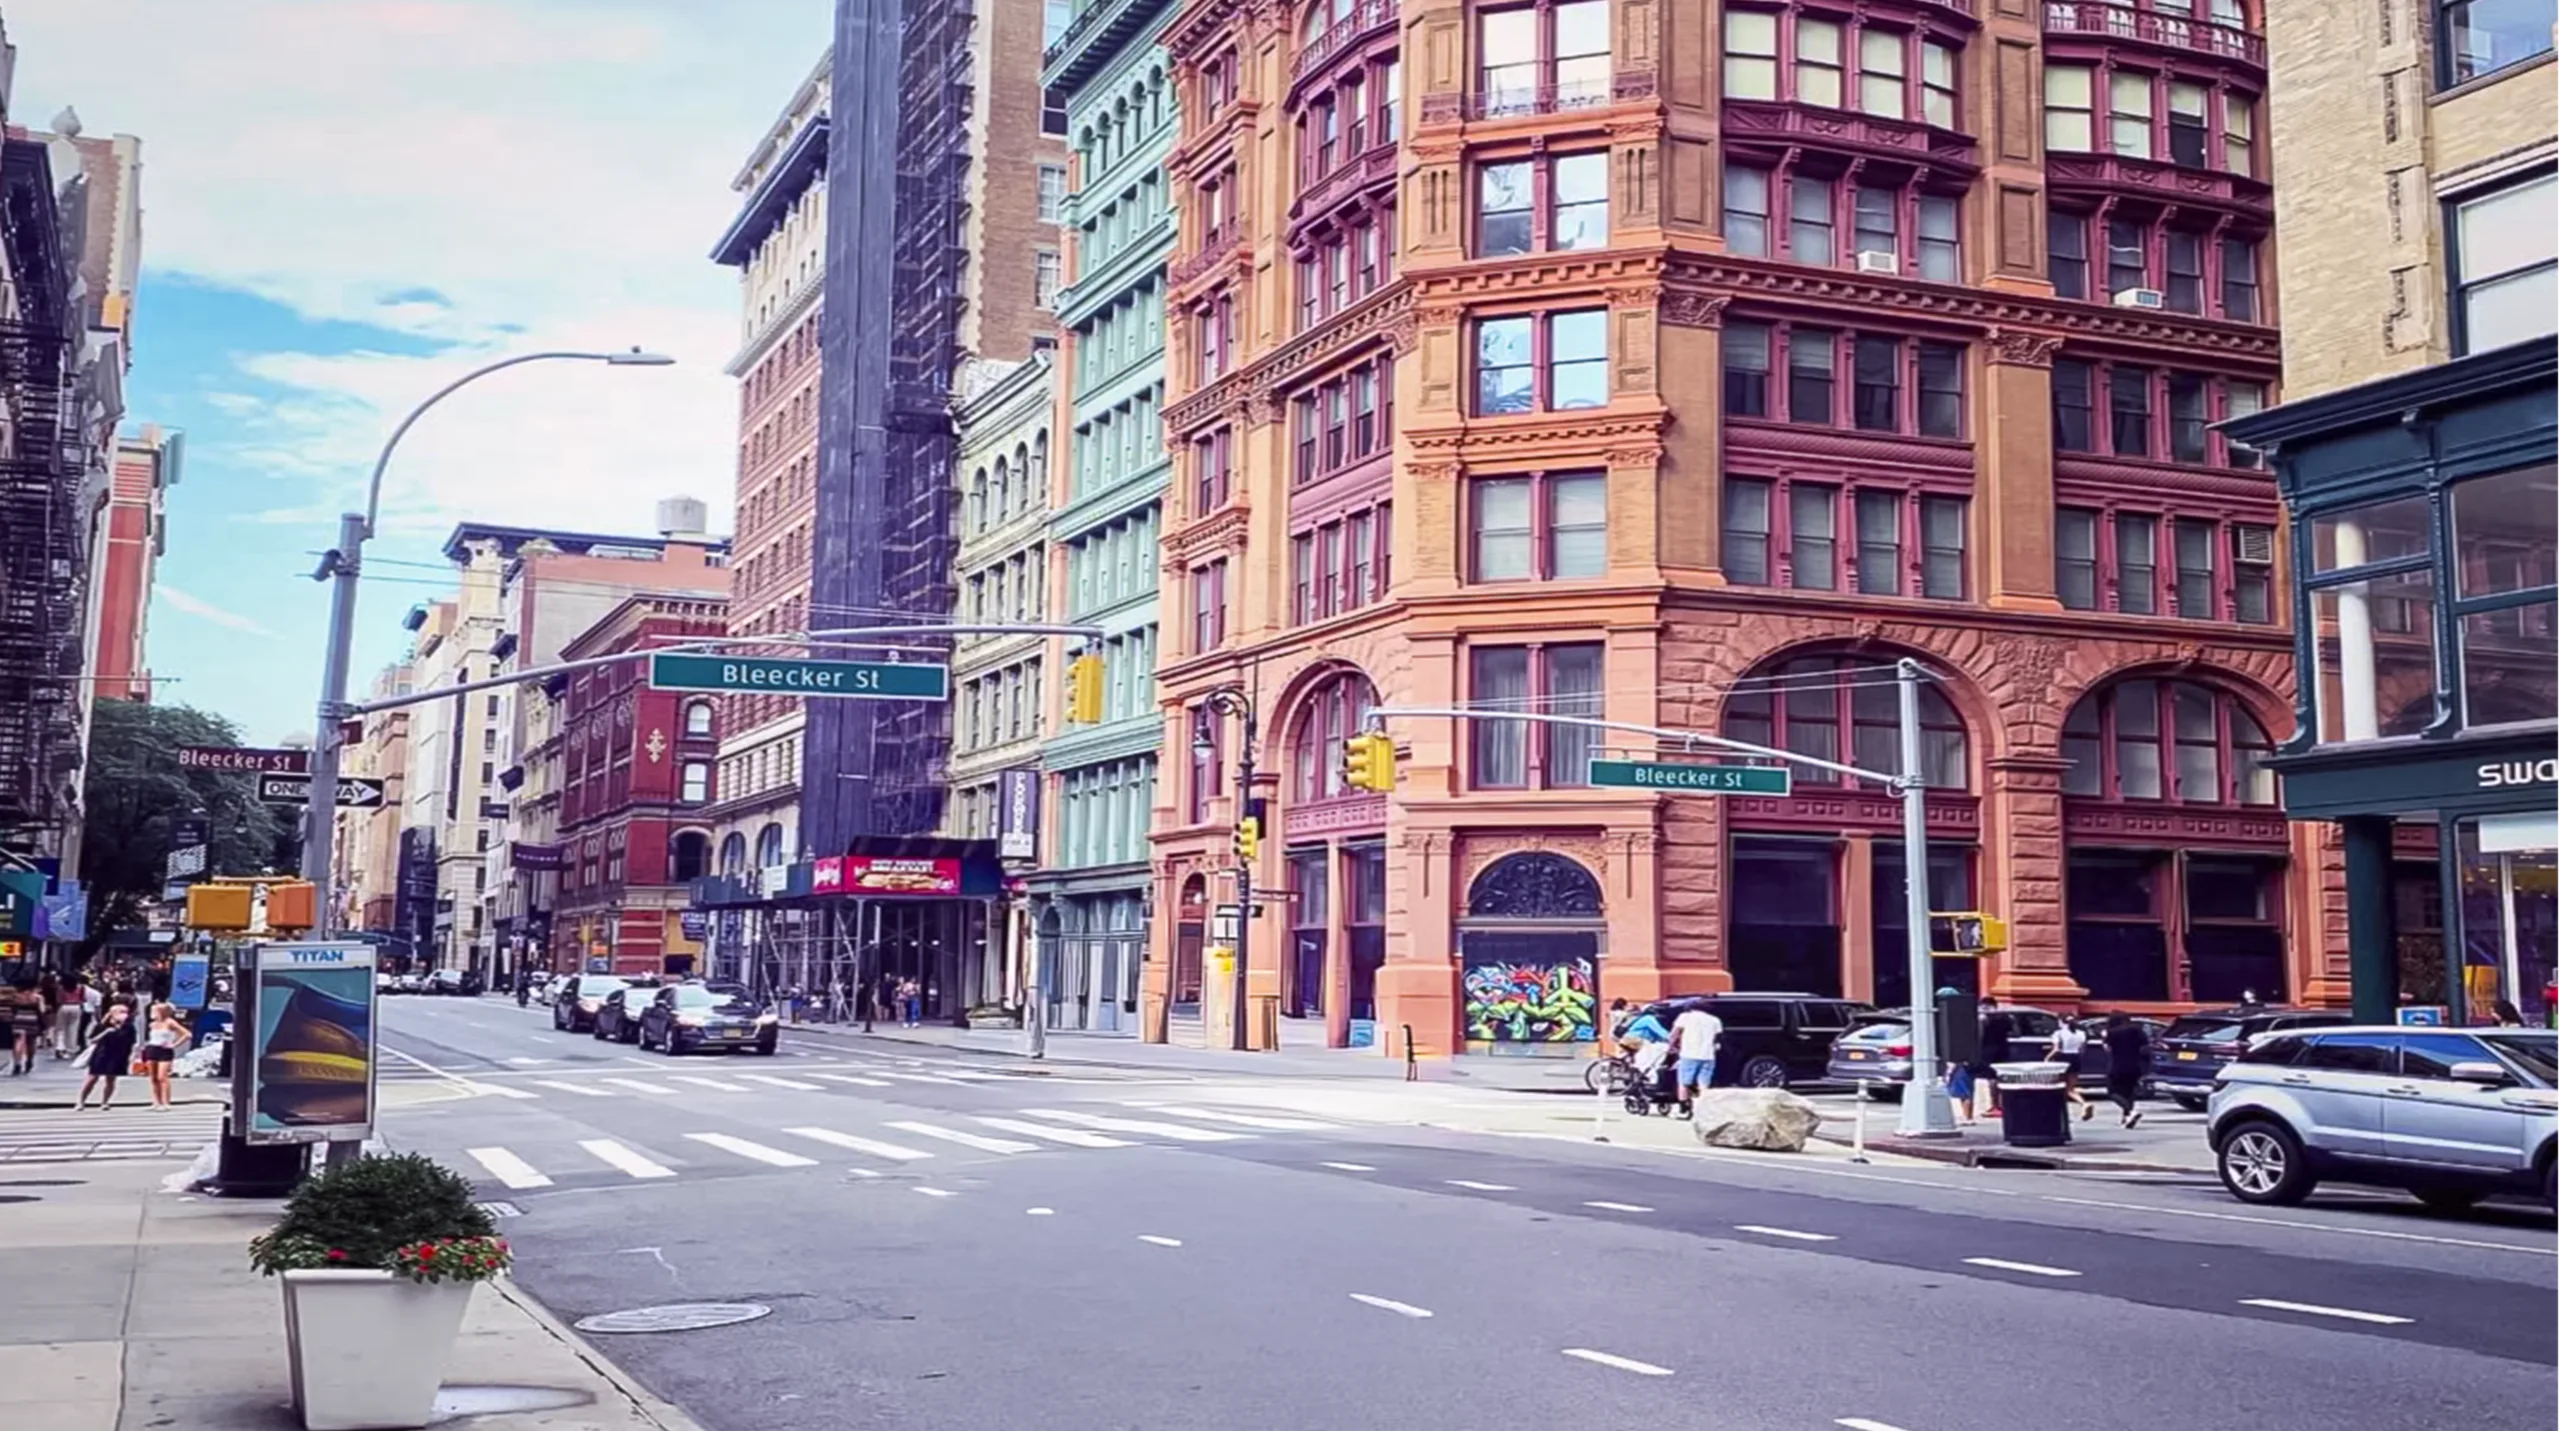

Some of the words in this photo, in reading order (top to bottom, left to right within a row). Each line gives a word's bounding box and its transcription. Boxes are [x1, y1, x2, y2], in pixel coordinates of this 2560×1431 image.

[722, 664, 843, 688] Bleecker
[856, 670, 880, 689] St
[179, 750, 264, 770] Bleecker
[272, 755, 291, 771] St
[1635, 767, 1718, 786] Bleecker
[1725, 772, 1743, 788] St
[290, 950, 344, 962] TITAN
